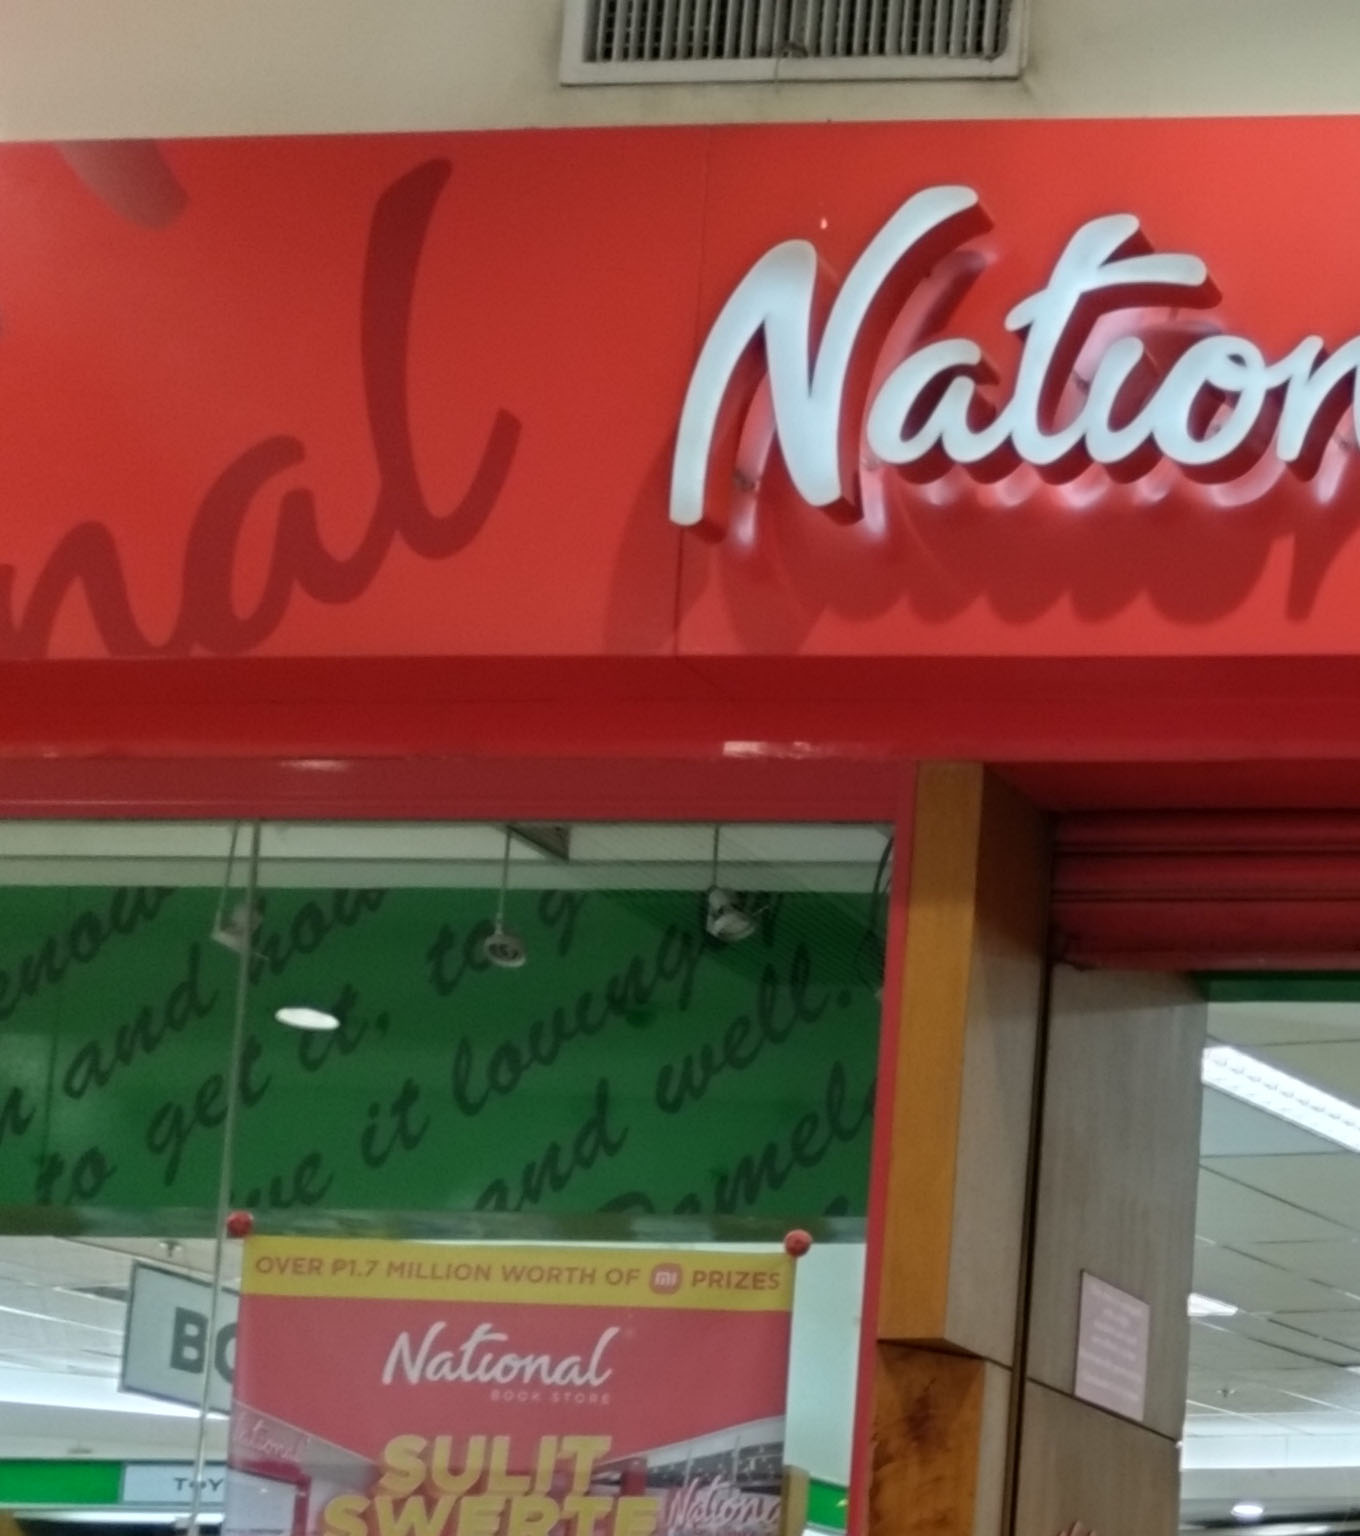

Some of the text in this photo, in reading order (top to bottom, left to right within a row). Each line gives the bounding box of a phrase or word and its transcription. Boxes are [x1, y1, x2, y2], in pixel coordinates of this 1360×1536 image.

[256, 1256, 322, 1277] OVER
[386, 1260, 491, 1283] MILLION
[501, 1263, 597, 1286] WORTH
[605, 1267, 641, 1287] OF
[691, 1269, 782, 1291] PRIZES
[381, 1321, 621, 1387] National
[490, 1389, 611, 1406] BOOK STORE
[377, 1434, 614, 1498] SULIT
